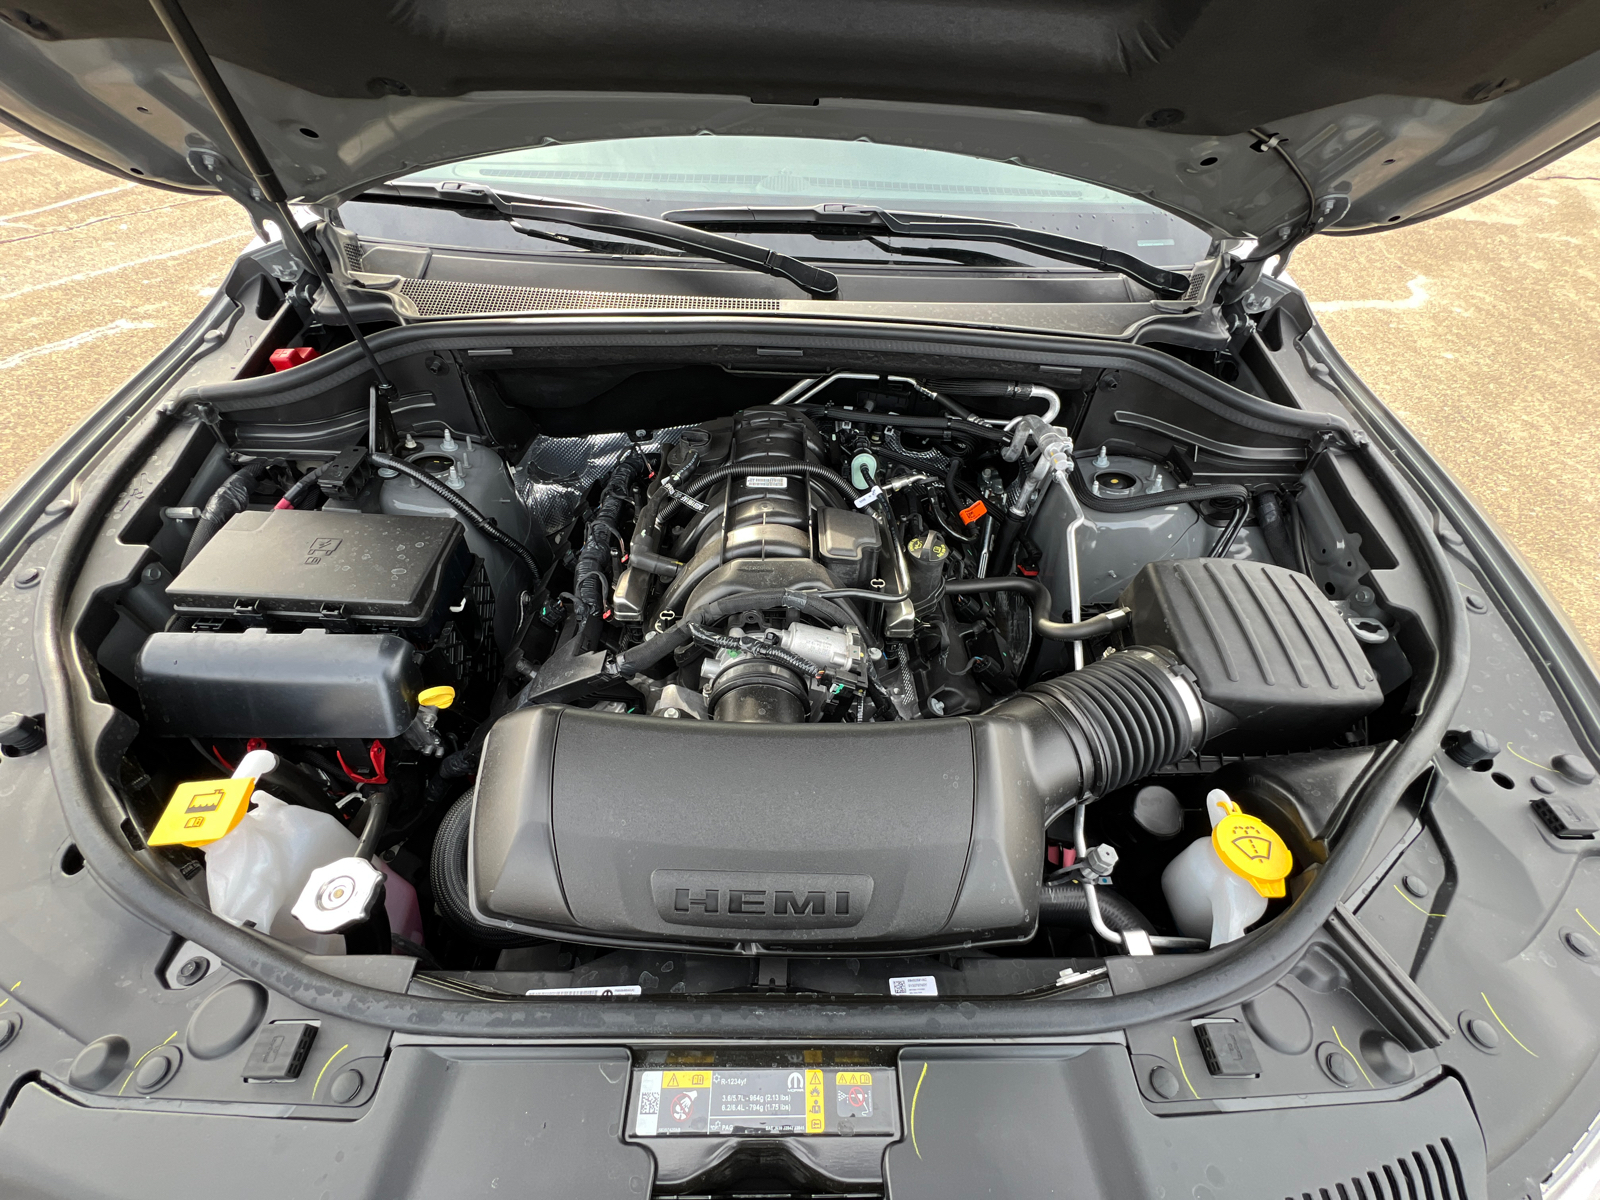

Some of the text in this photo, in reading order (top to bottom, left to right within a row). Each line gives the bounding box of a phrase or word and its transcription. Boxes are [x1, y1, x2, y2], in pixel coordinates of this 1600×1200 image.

[675, 888, 850, 916] HEMI
[720, 1078, 747, 1086] R-1234yf
[780, 1094, 791, 1102] lbs)
[749, 1103, 764, 1112] 794g
[765, 1103, 779, 1112] (1.75
[780, 1103, 791, 1112] lbs)
